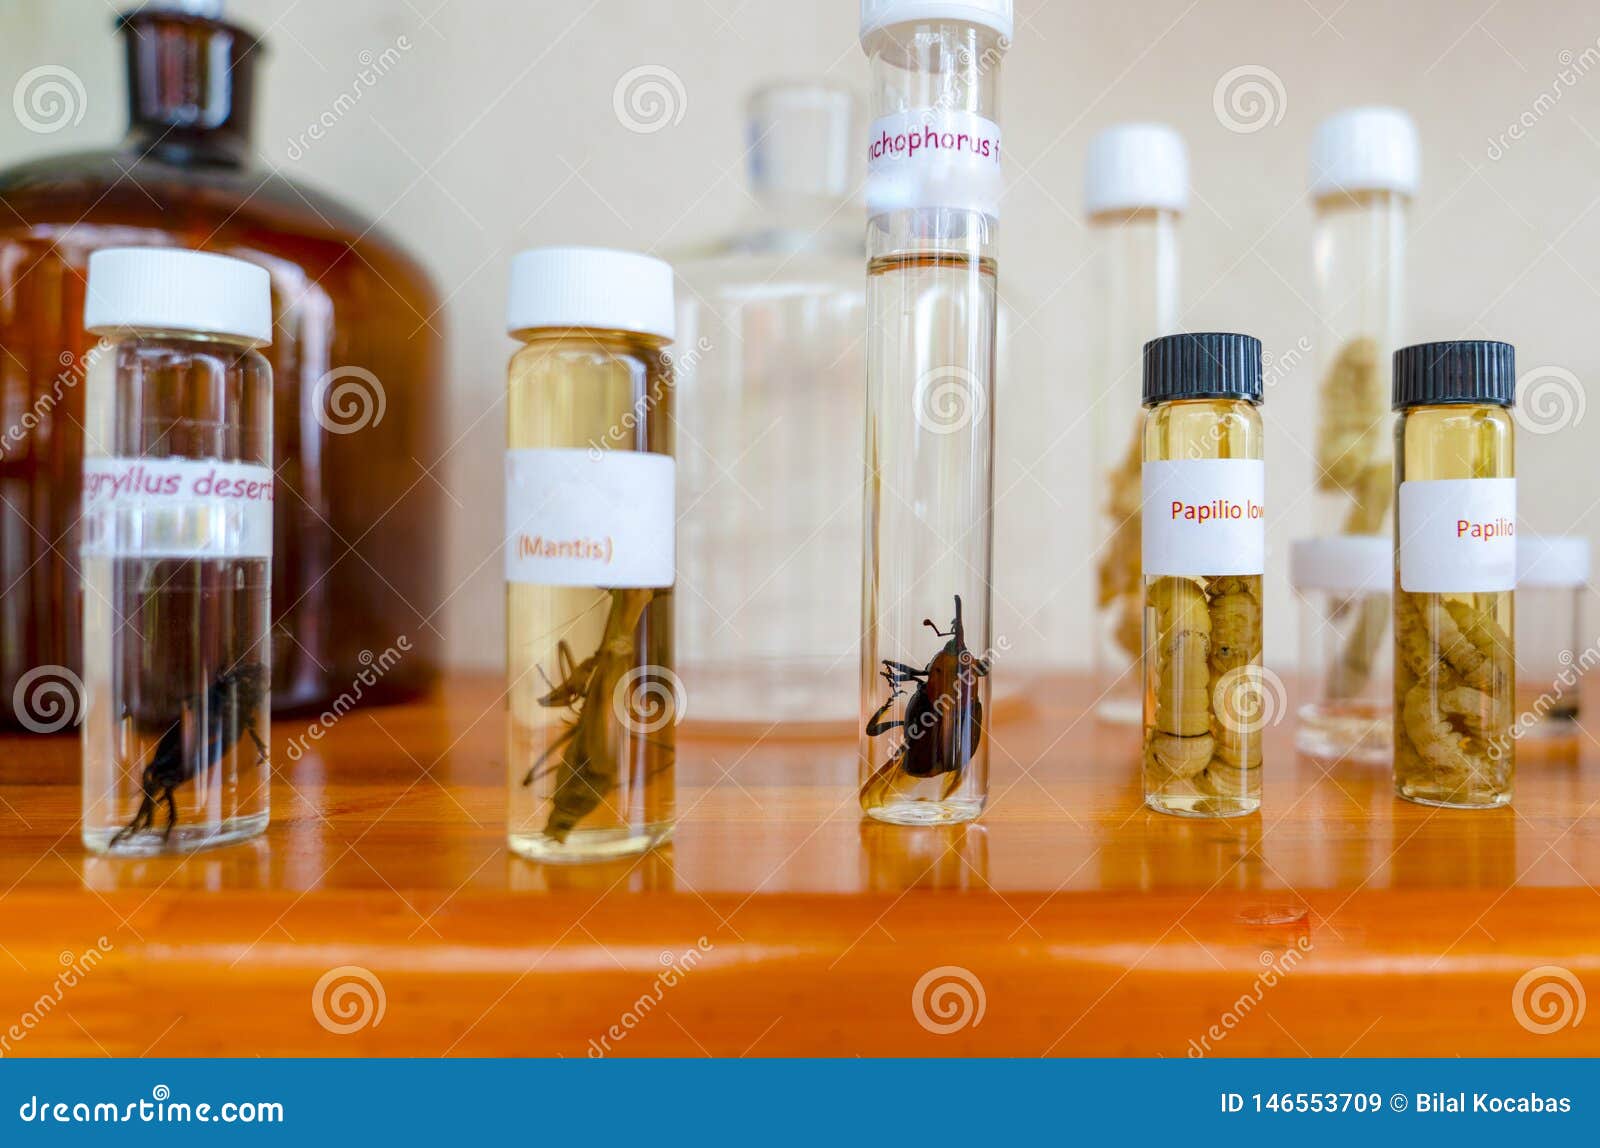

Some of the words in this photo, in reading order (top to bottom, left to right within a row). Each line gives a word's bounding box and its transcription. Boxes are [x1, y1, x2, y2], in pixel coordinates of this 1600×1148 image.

[1171, 500, 1242, 524] Papilio
[1456, 518, 1514, 542] Papilio
[519, 534, 613, 565] (Mantis)
